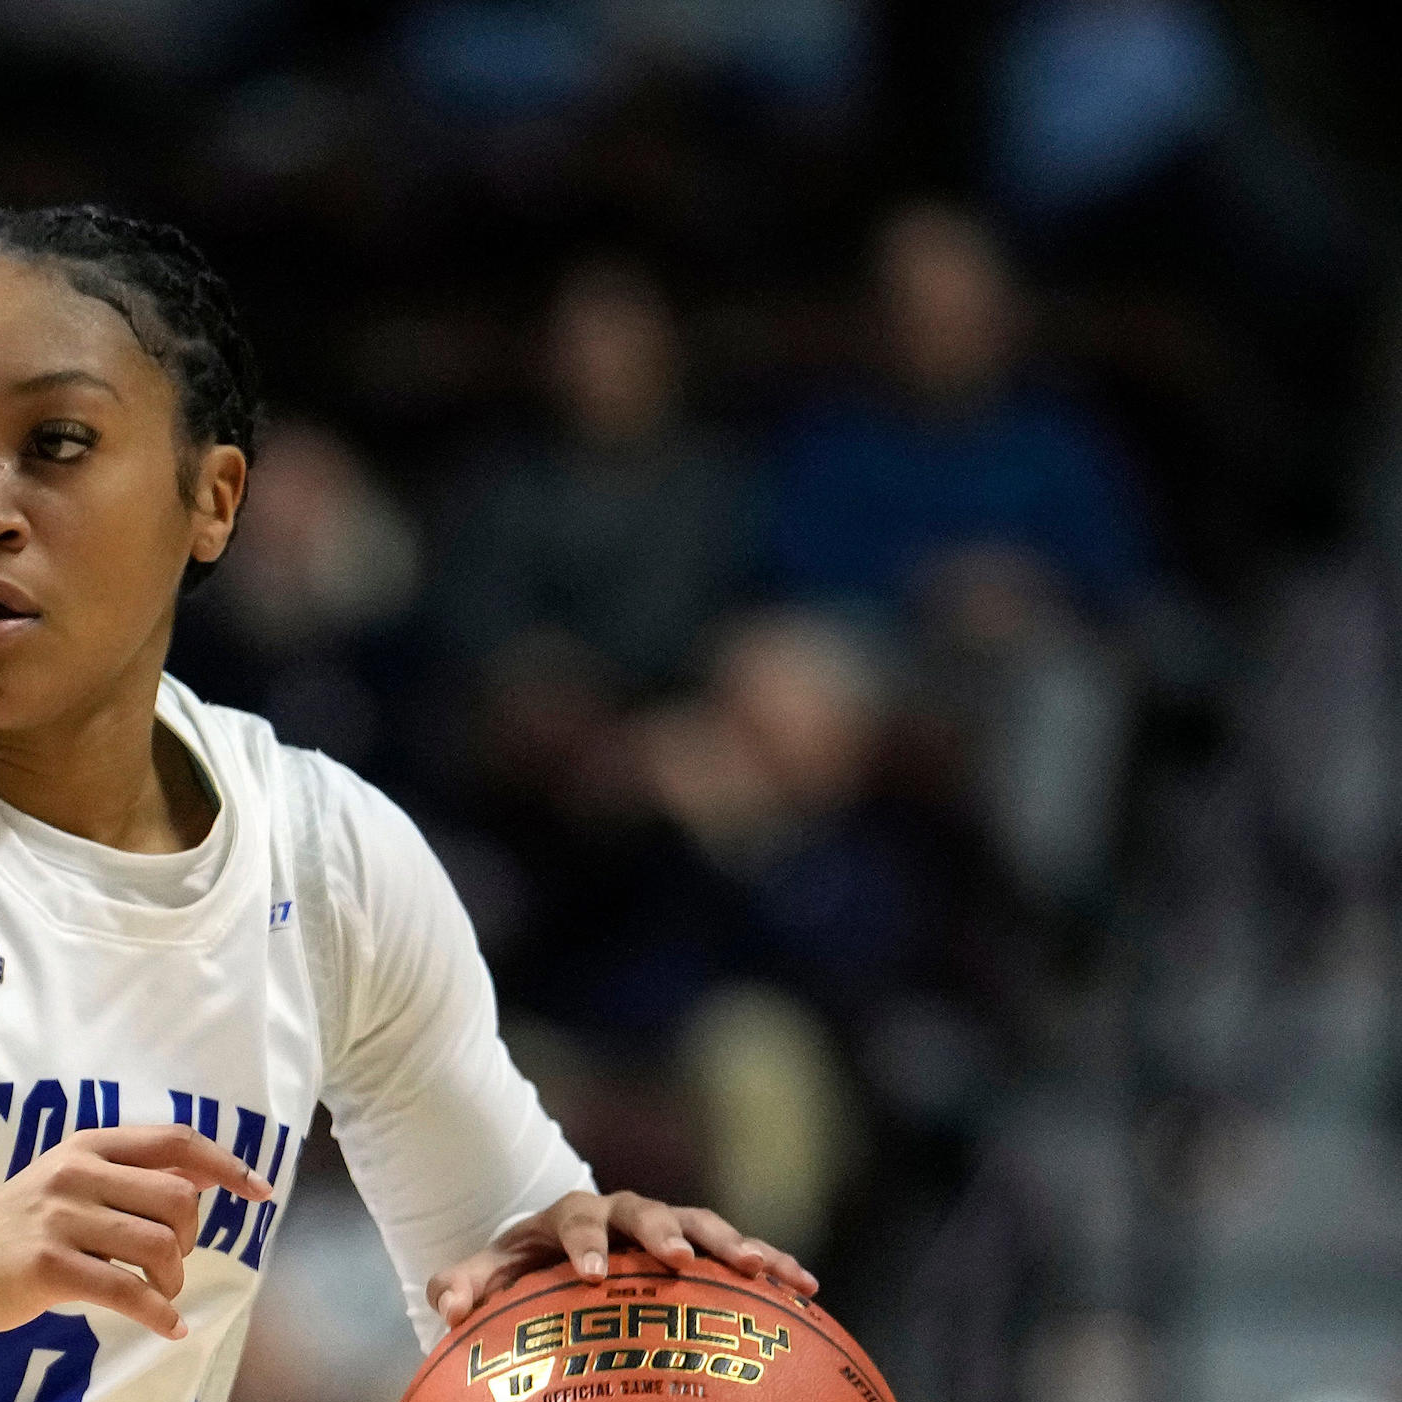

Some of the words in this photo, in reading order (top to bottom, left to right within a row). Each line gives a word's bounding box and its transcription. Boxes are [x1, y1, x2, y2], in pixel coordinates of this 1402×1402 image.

[467, 1303, 792, 1386] LEGACY
[562, 1348, 765, 1385] 1000
[620, 1379, 664, 1395] GAME
